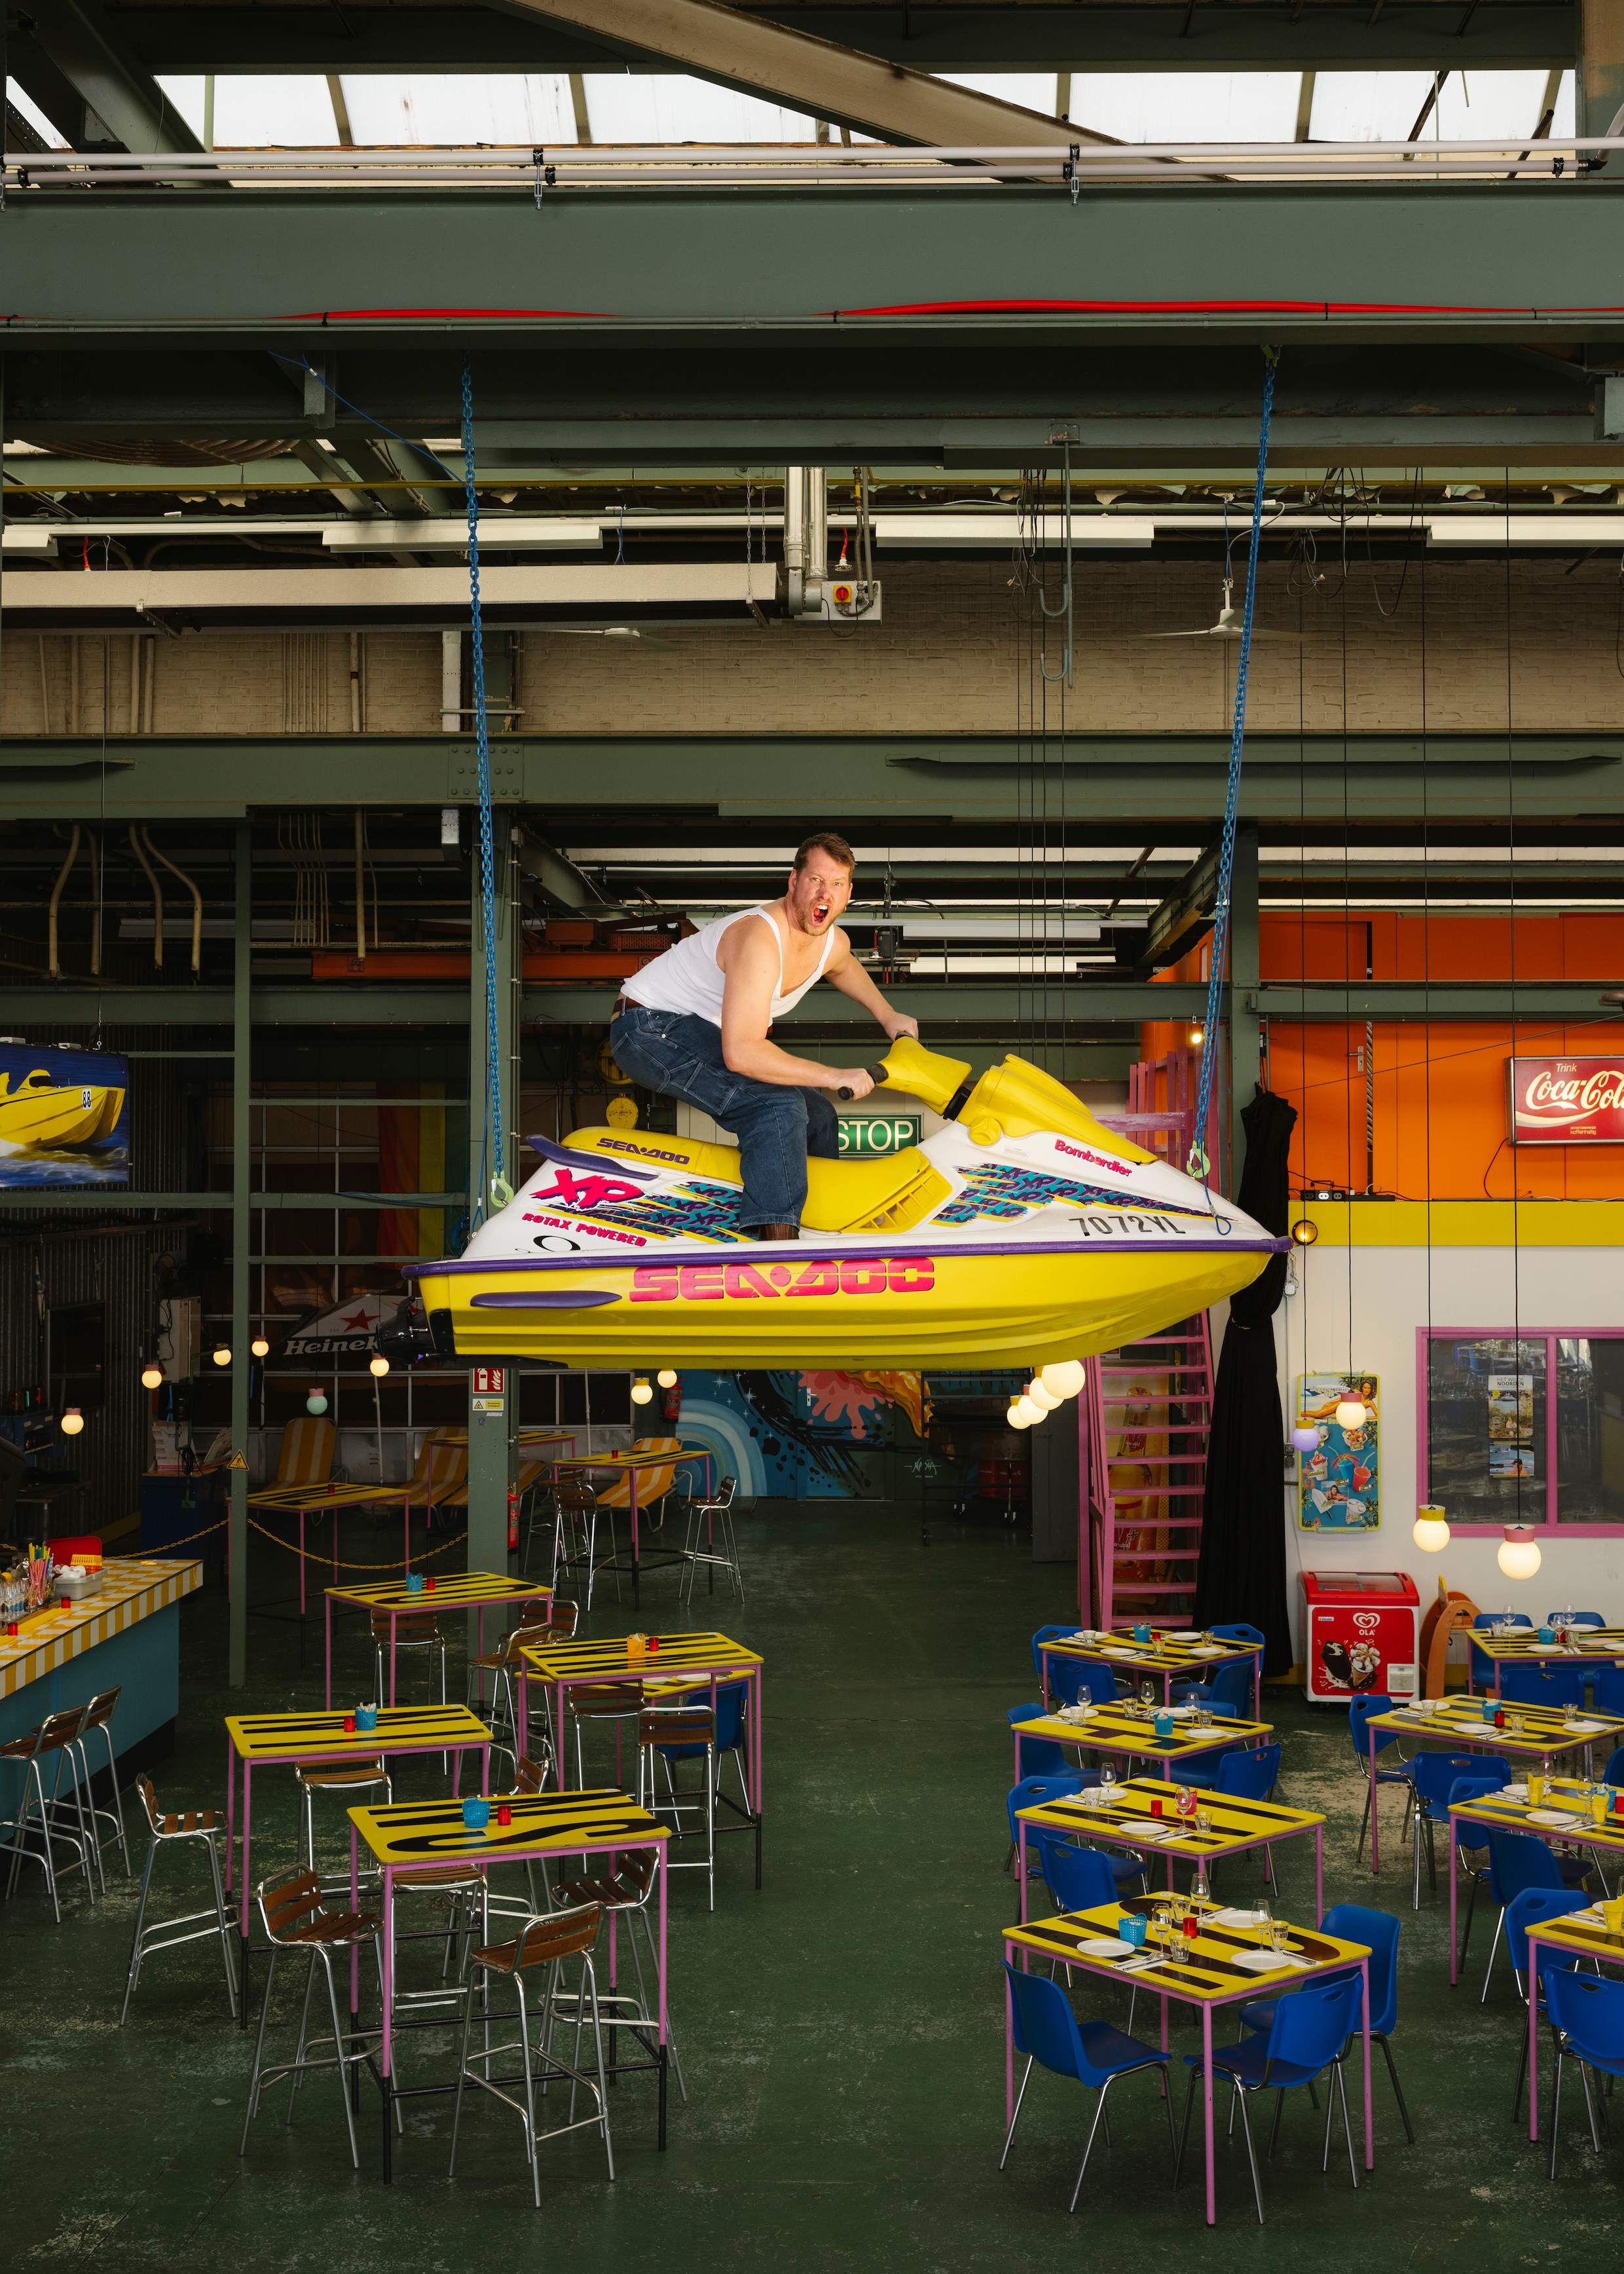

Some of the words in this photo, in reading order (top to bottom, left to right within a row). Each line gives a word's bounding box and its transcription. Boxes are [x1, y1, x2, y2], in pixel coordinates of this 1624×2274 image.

[1556, 1063, 1577, 1072] Trink
[83, 1090, 91, 1108] 88
[1525, 1070, 1624, 1110] Coca-Col
[838, 1120, 913, 1151] STOP
[1054, 1138, 1132, 1177] Bombardier
[529, 1168, 646, 1210] XP
[521, 1212, 572, 1230] ROTAX
[576, 1223, 647, 1247] POWERED
[1068, 1215, 1187, 1237] 7072YL
[283, 1335, 378, 1356] Heinek
